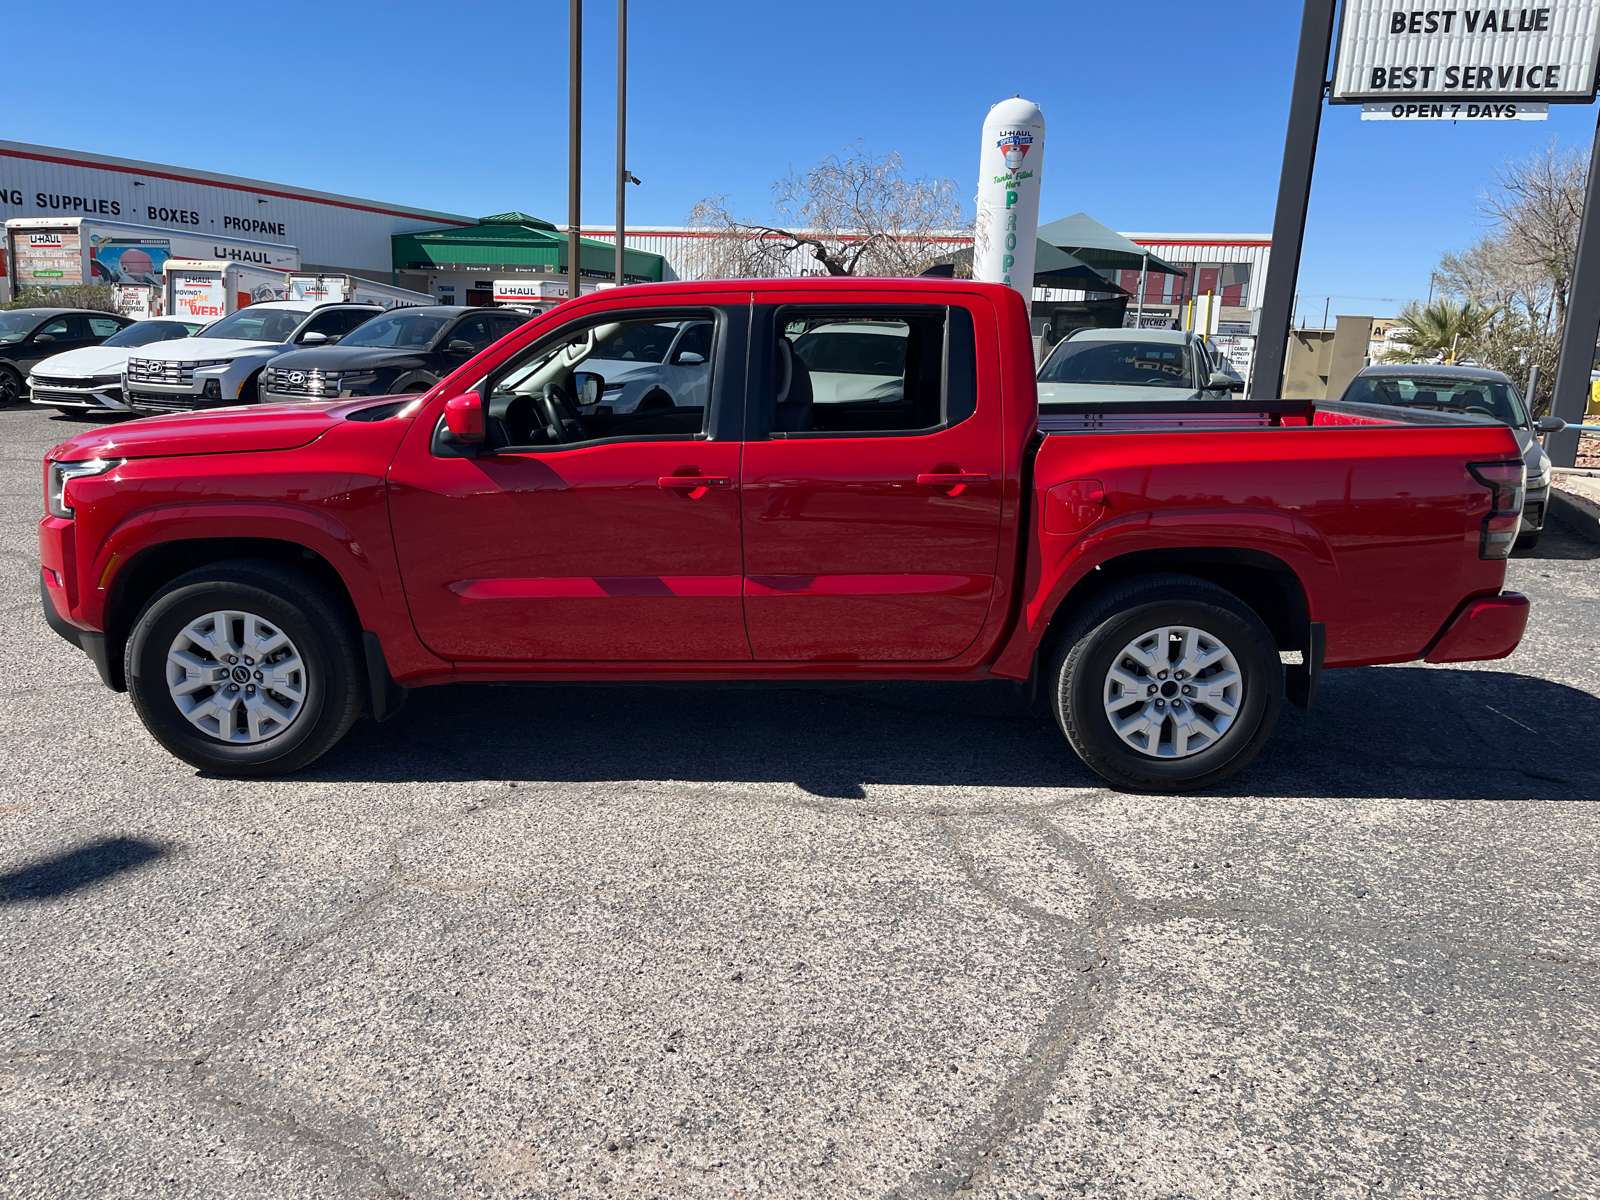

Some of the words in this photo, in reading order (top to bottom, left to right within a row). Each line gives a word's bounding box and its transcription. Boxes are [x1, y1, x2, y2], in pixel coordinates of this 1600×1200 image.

[1390, 10, 1456, 34] BEST
[1464, 8, 1550, 33] VALUE
[1370, 66, 1435, 89] BEST
[1444, 65, 1561, 89] SERVICE
[1391, 104, 1443, 118] OPEN
[1450, 104, 1461, 118] 7
[1467, 104, 1517, 118] DAYS
[993, 173, 1012, 184] Tanks
[1015, 170, 1033, 180] Filled
[1005, 181, 1021, 189] Here
[36, 192, 120, 215] SUPPLIES
[148, 206, 199, 225] BOXES
[224, 216, 285, 235] PROPANE
[30, 234, 61, 243] U-HAUL
[214, 246, 272, 264] U-HAUL
[499, 287, 535, 295] U-HAUL
[178, 298, 197, 307] THE
[190, 306, 222, 315] WEB!
